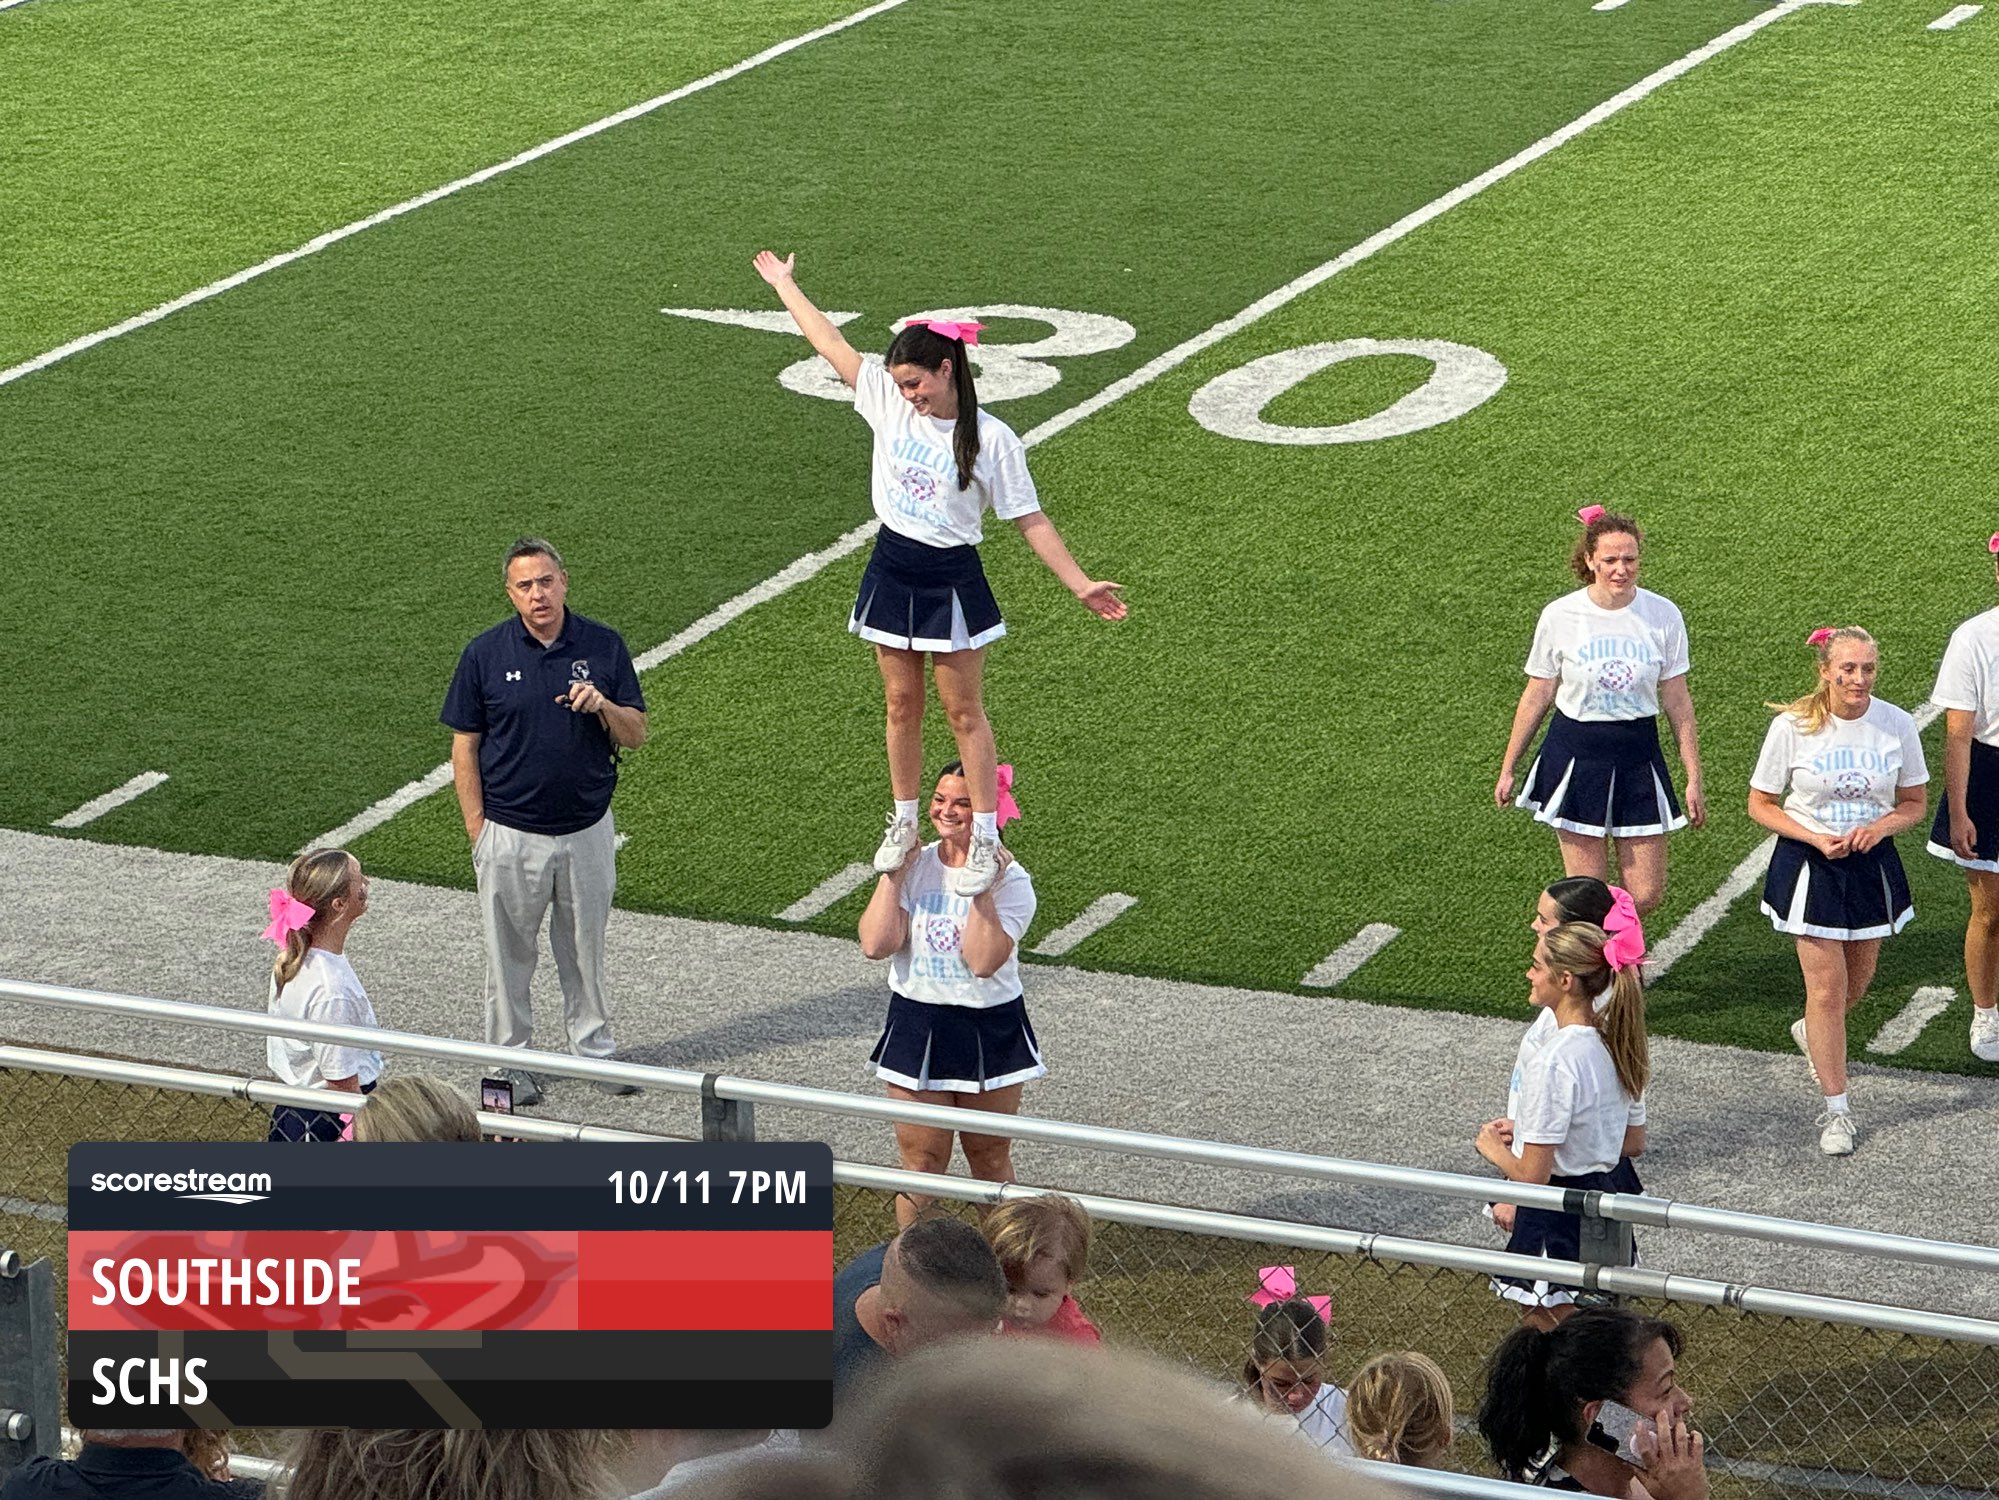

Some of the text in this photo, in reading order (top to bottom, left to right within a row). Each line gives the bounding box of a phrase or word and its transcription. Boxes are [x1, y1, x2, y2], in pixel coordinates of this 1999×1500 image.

[1578, 637, 1650, 664] SHILOH
[1813, 749, 1889, 775] SHILOH
[910, 892, 969, 917] HILO
